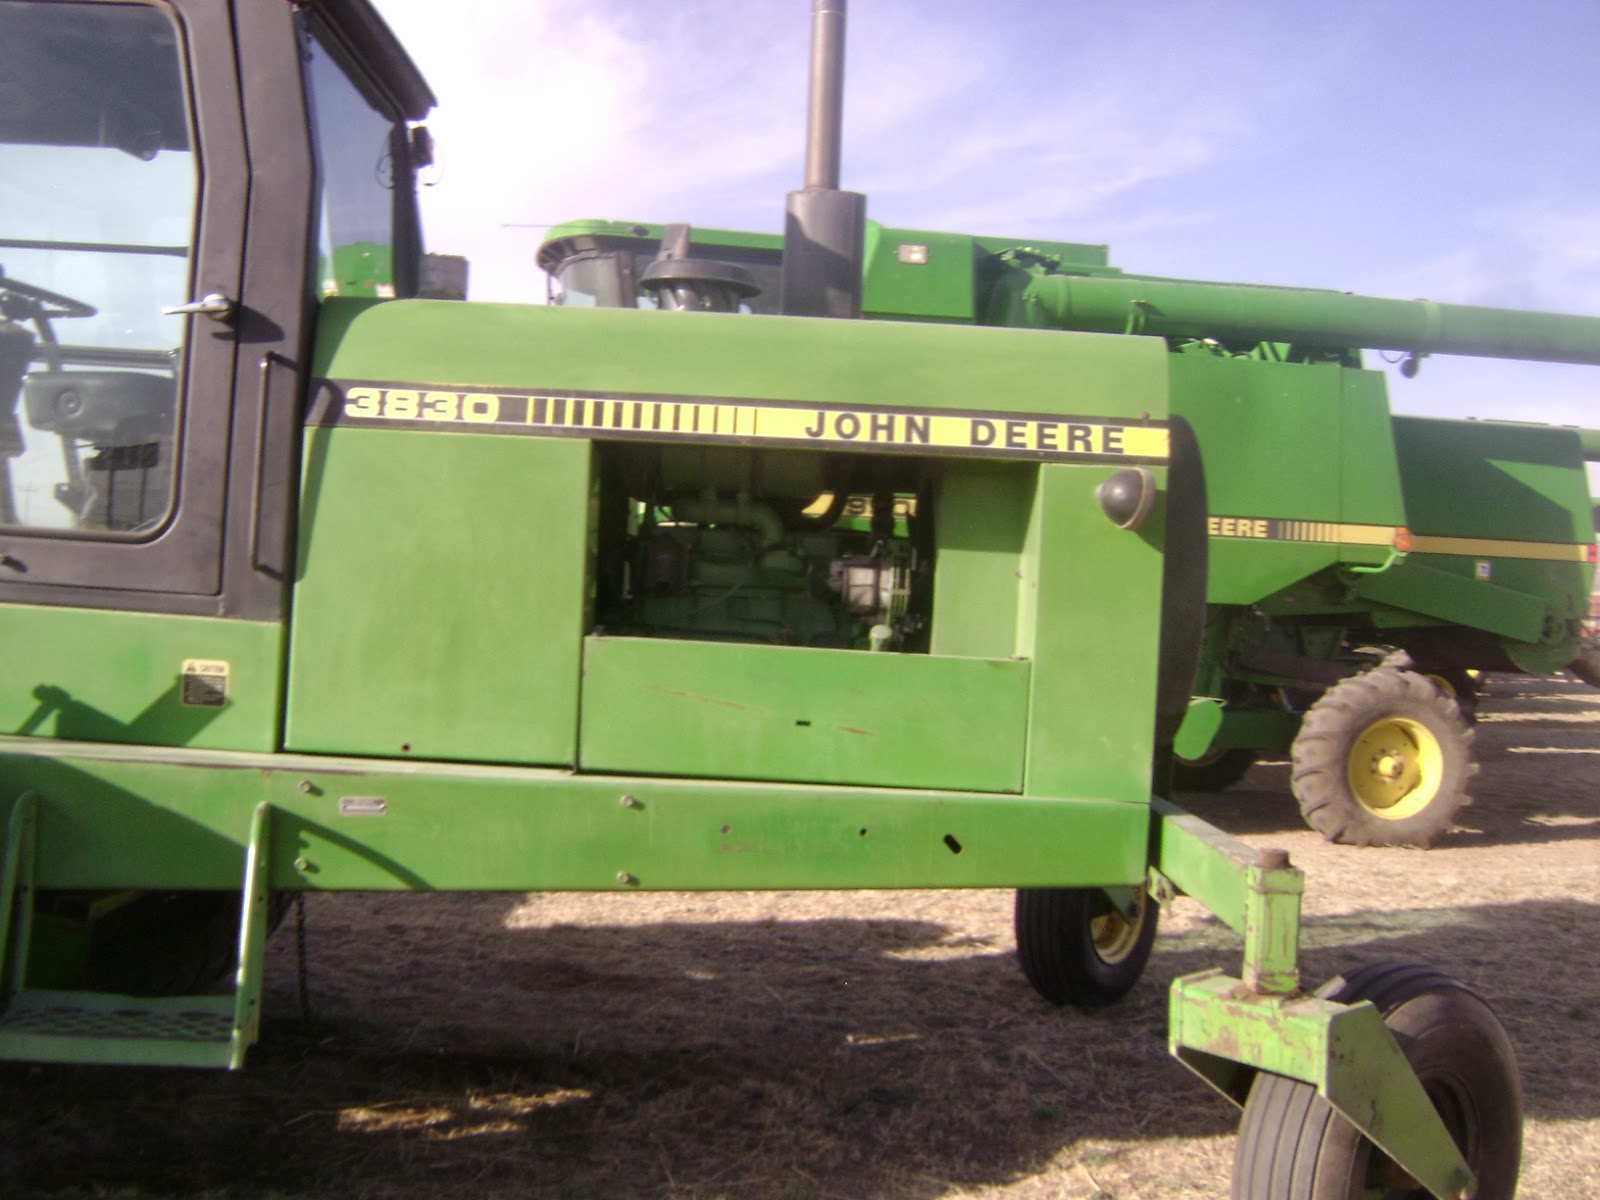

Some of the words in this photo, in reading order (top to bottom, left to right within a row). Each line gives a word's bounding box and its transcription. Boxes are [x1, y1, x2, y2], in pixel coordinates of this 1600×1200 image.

[345, 387, 499, 423] 3830
[804, 411, 931, 444] JOHN
[970, 419, 1125, 454] DEERE
[1207, 517, 1268, 538] EERE
